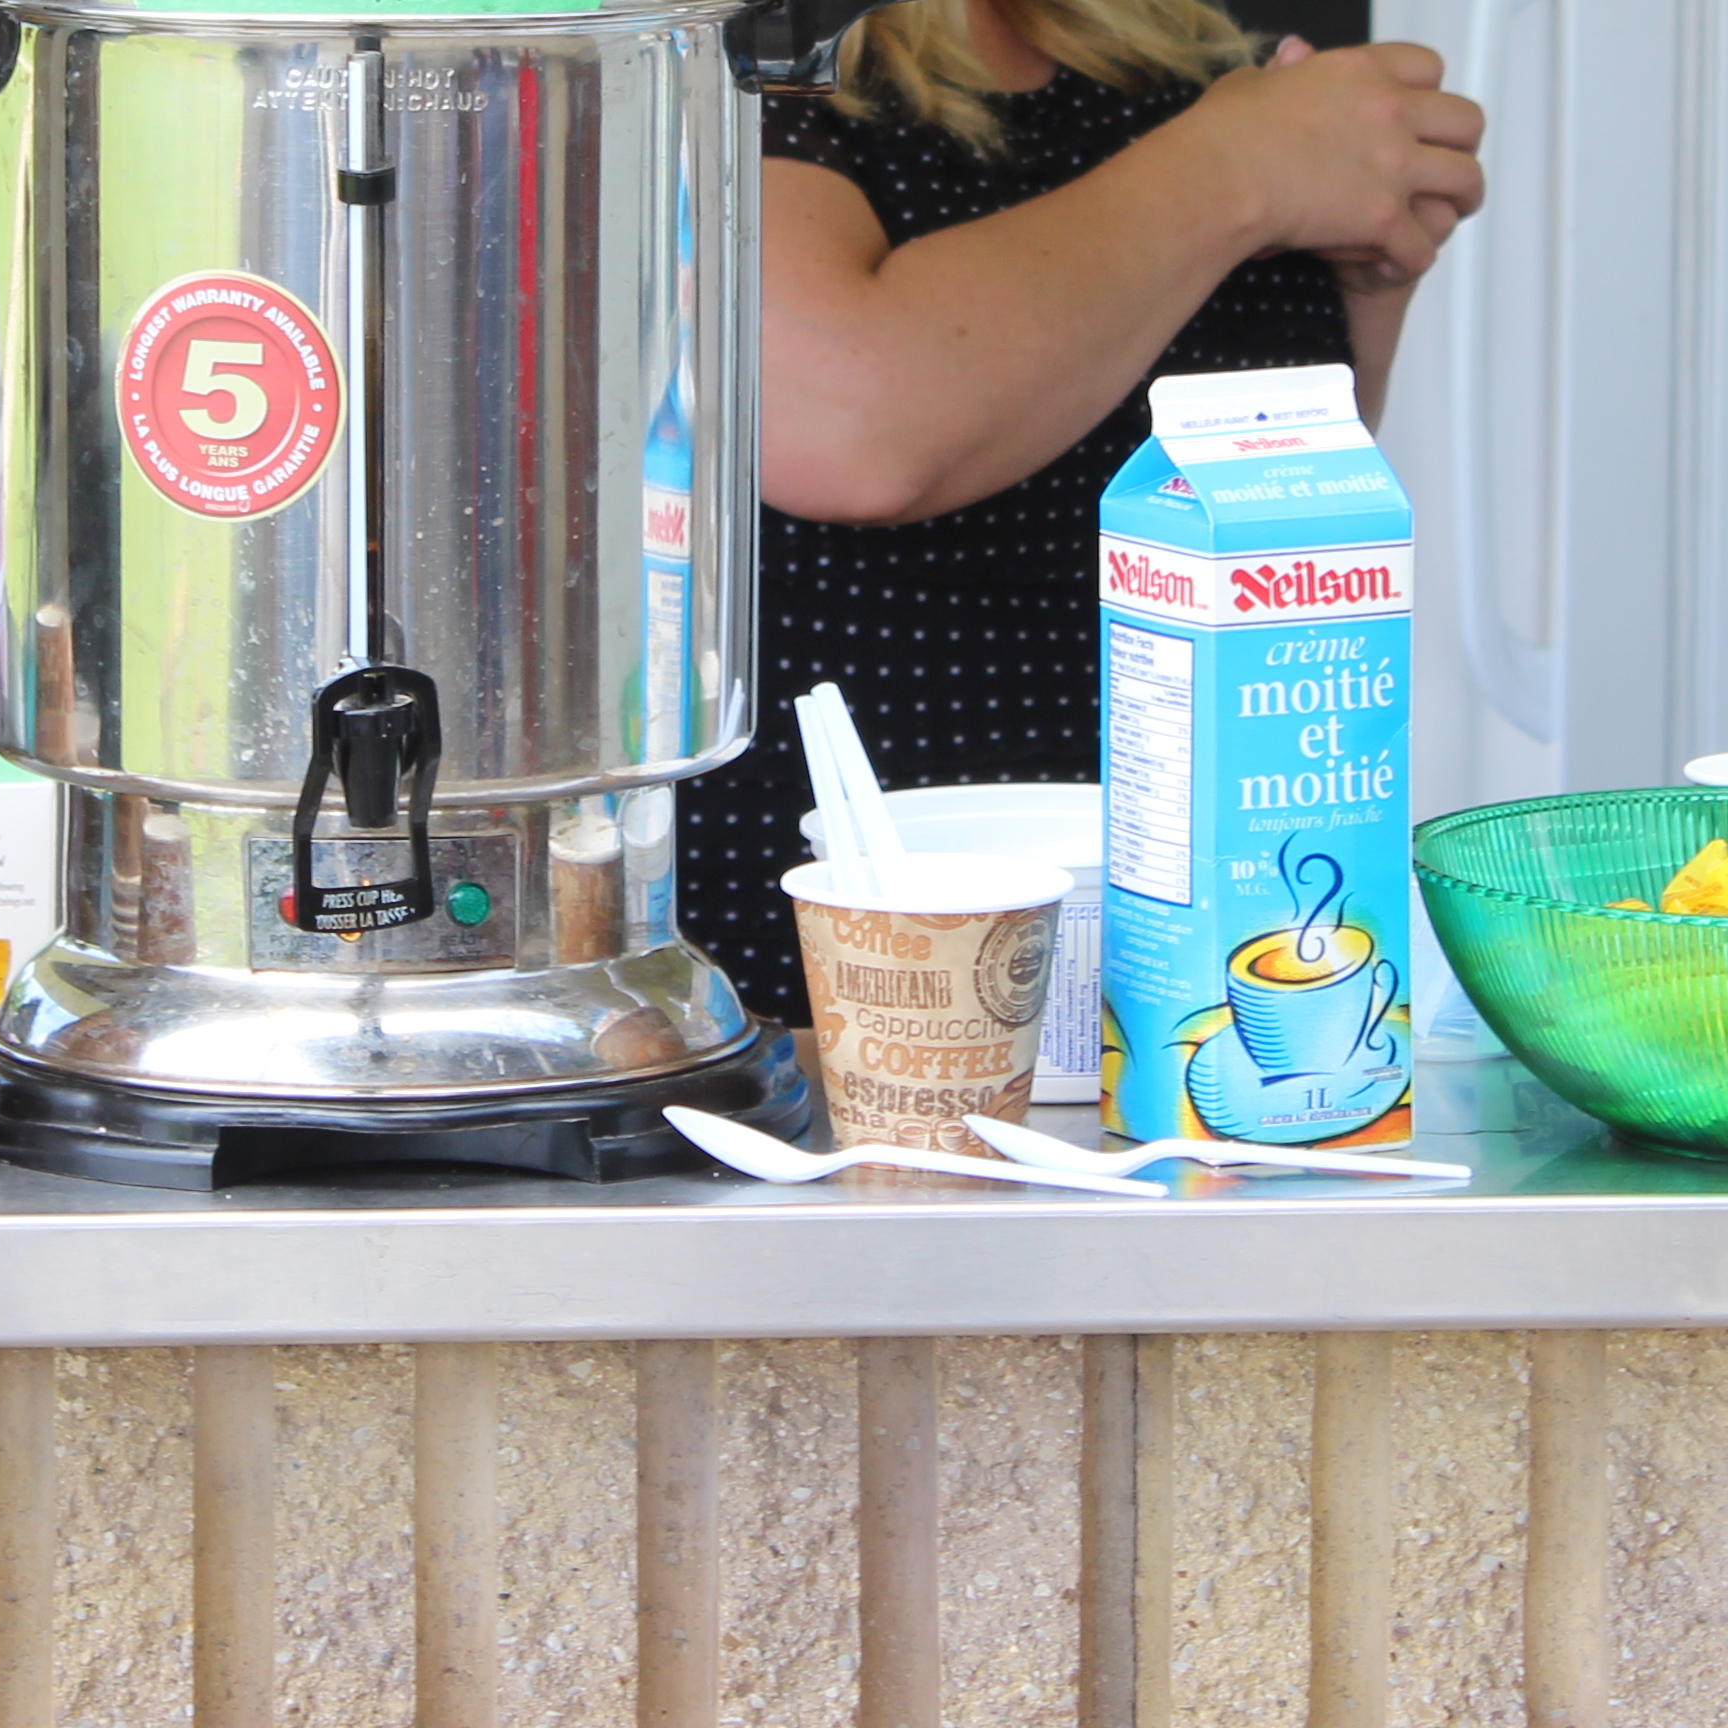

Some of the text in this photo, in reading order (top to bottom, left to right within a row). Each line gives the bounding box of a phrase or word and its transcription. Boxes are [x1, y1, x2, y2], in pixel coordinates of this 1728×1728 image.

[170, 288, 266, 314] WARRANTY
[129, 307, 173, 381] LONGEST
[263, 306, 327, 391] AVAILABLE
[178, 339, 269, 440] 5
[132, 413, 321, 502] LA PLUS LONGUE GARANTIE
[198, 443, 249, 457] YEARS
[207, 457, 240, 468] ANS
[1210, 478, 1286, 505] moitié
[1289, 476, 1314, 498] et
[1318, 470, 1390, 497] moitié
[1108, 549, 1196, 609] Neilson
[1230, 559, 1393, 613] Neilson
[1264, 628, 1368, 667] crème
[1238, 657, 1396, 718] moitié
[1299, 713, 1347, 759] et
[1238, 749, 1395, 811] moitié
[1248, 812, 1325, 835] toujours
[1234, 882, 1272, 898] M.G.
[835, 959, 952, 1010] AMERICANO
[859, 1036, 1015, 1080] COFFEE
[830, 1101, 888, 1130] ocha
